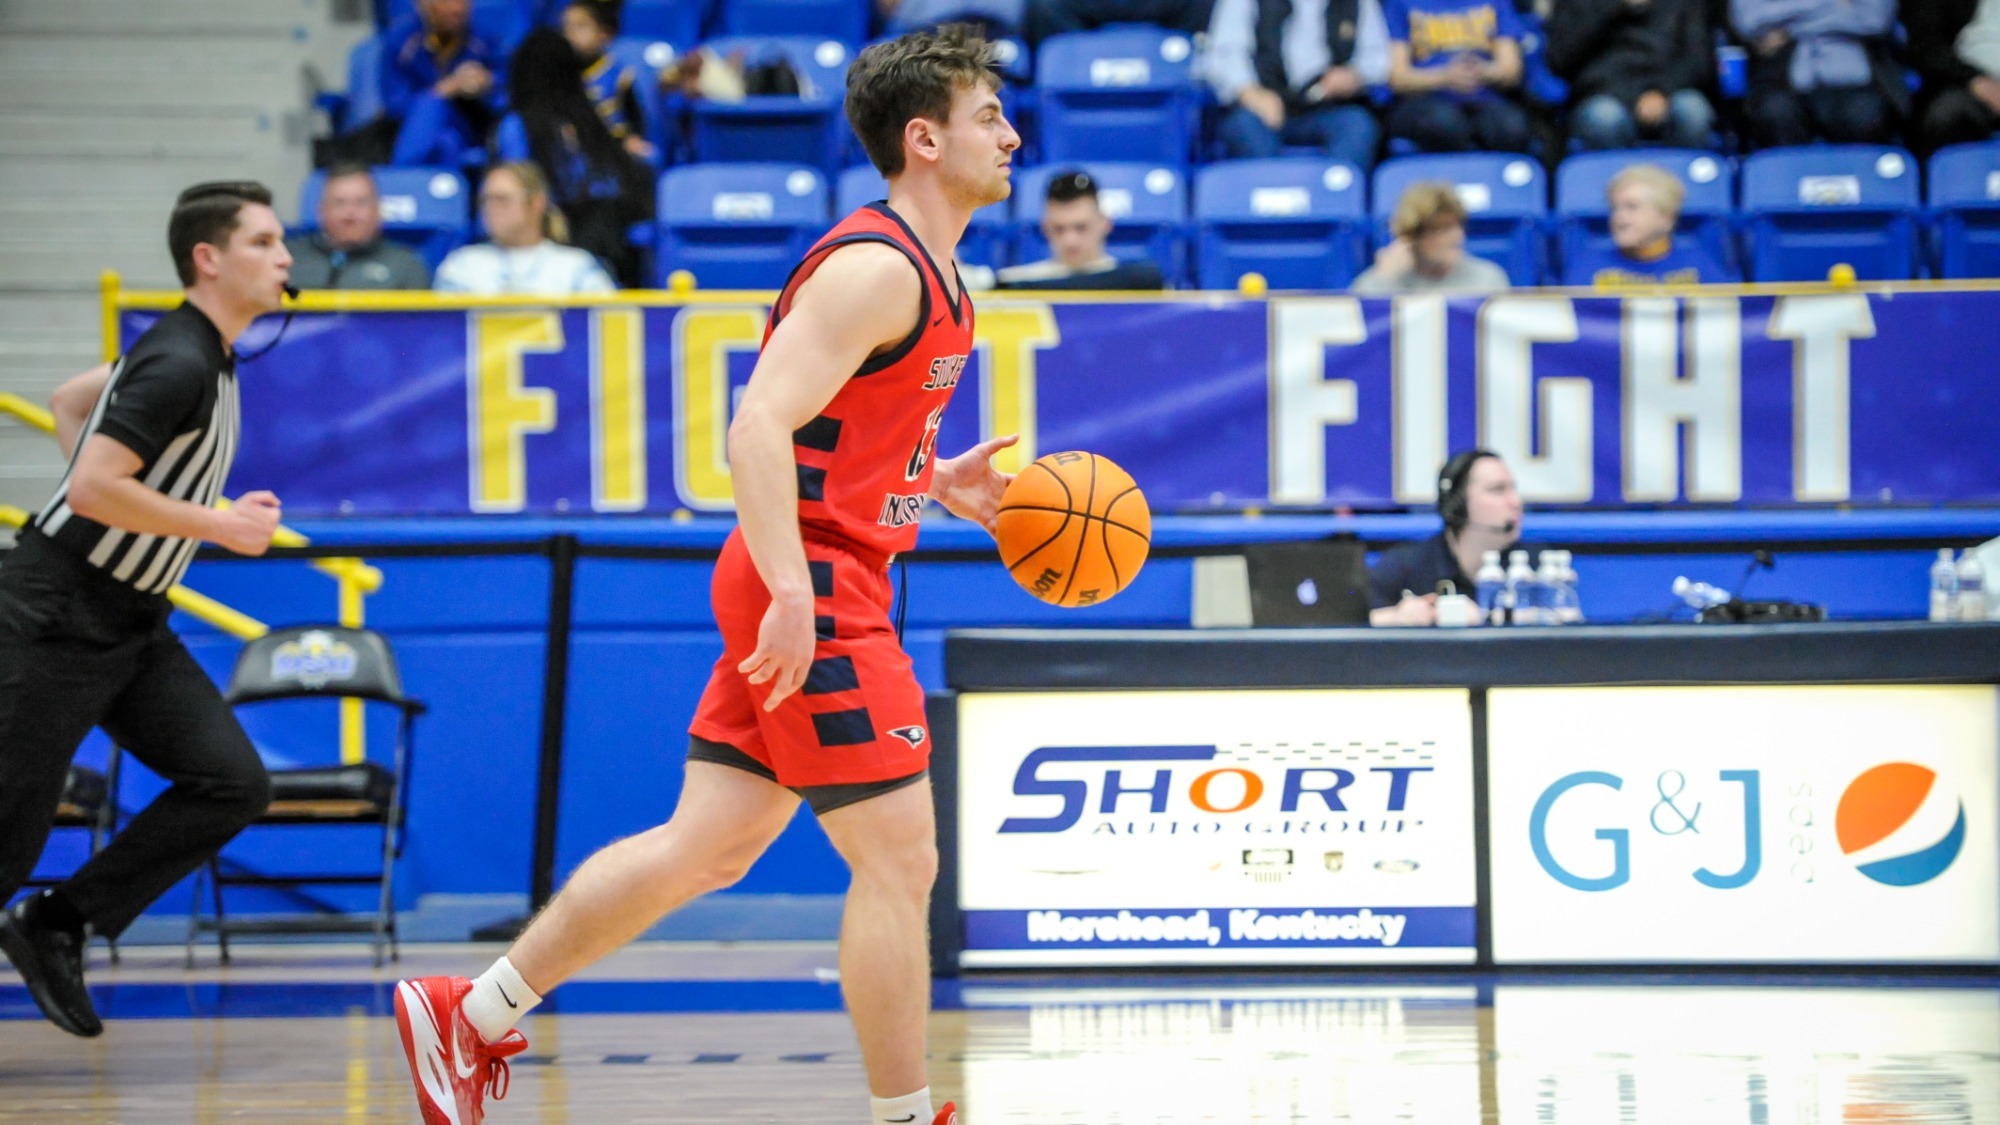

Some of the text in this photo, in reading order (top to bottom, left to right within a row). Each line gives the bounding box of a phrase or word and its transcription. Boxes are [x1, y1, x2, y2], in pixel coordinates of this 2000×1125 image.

[467, 300, 1061, 514] FIGT
[1266, 292, 1876, 504] FIGHT
[997, 744, 1435, 834] SHORT
[1092, 821, 1221, 835] AUTO
[1026, 907, 1407, 946] Morehead, Kentucky
